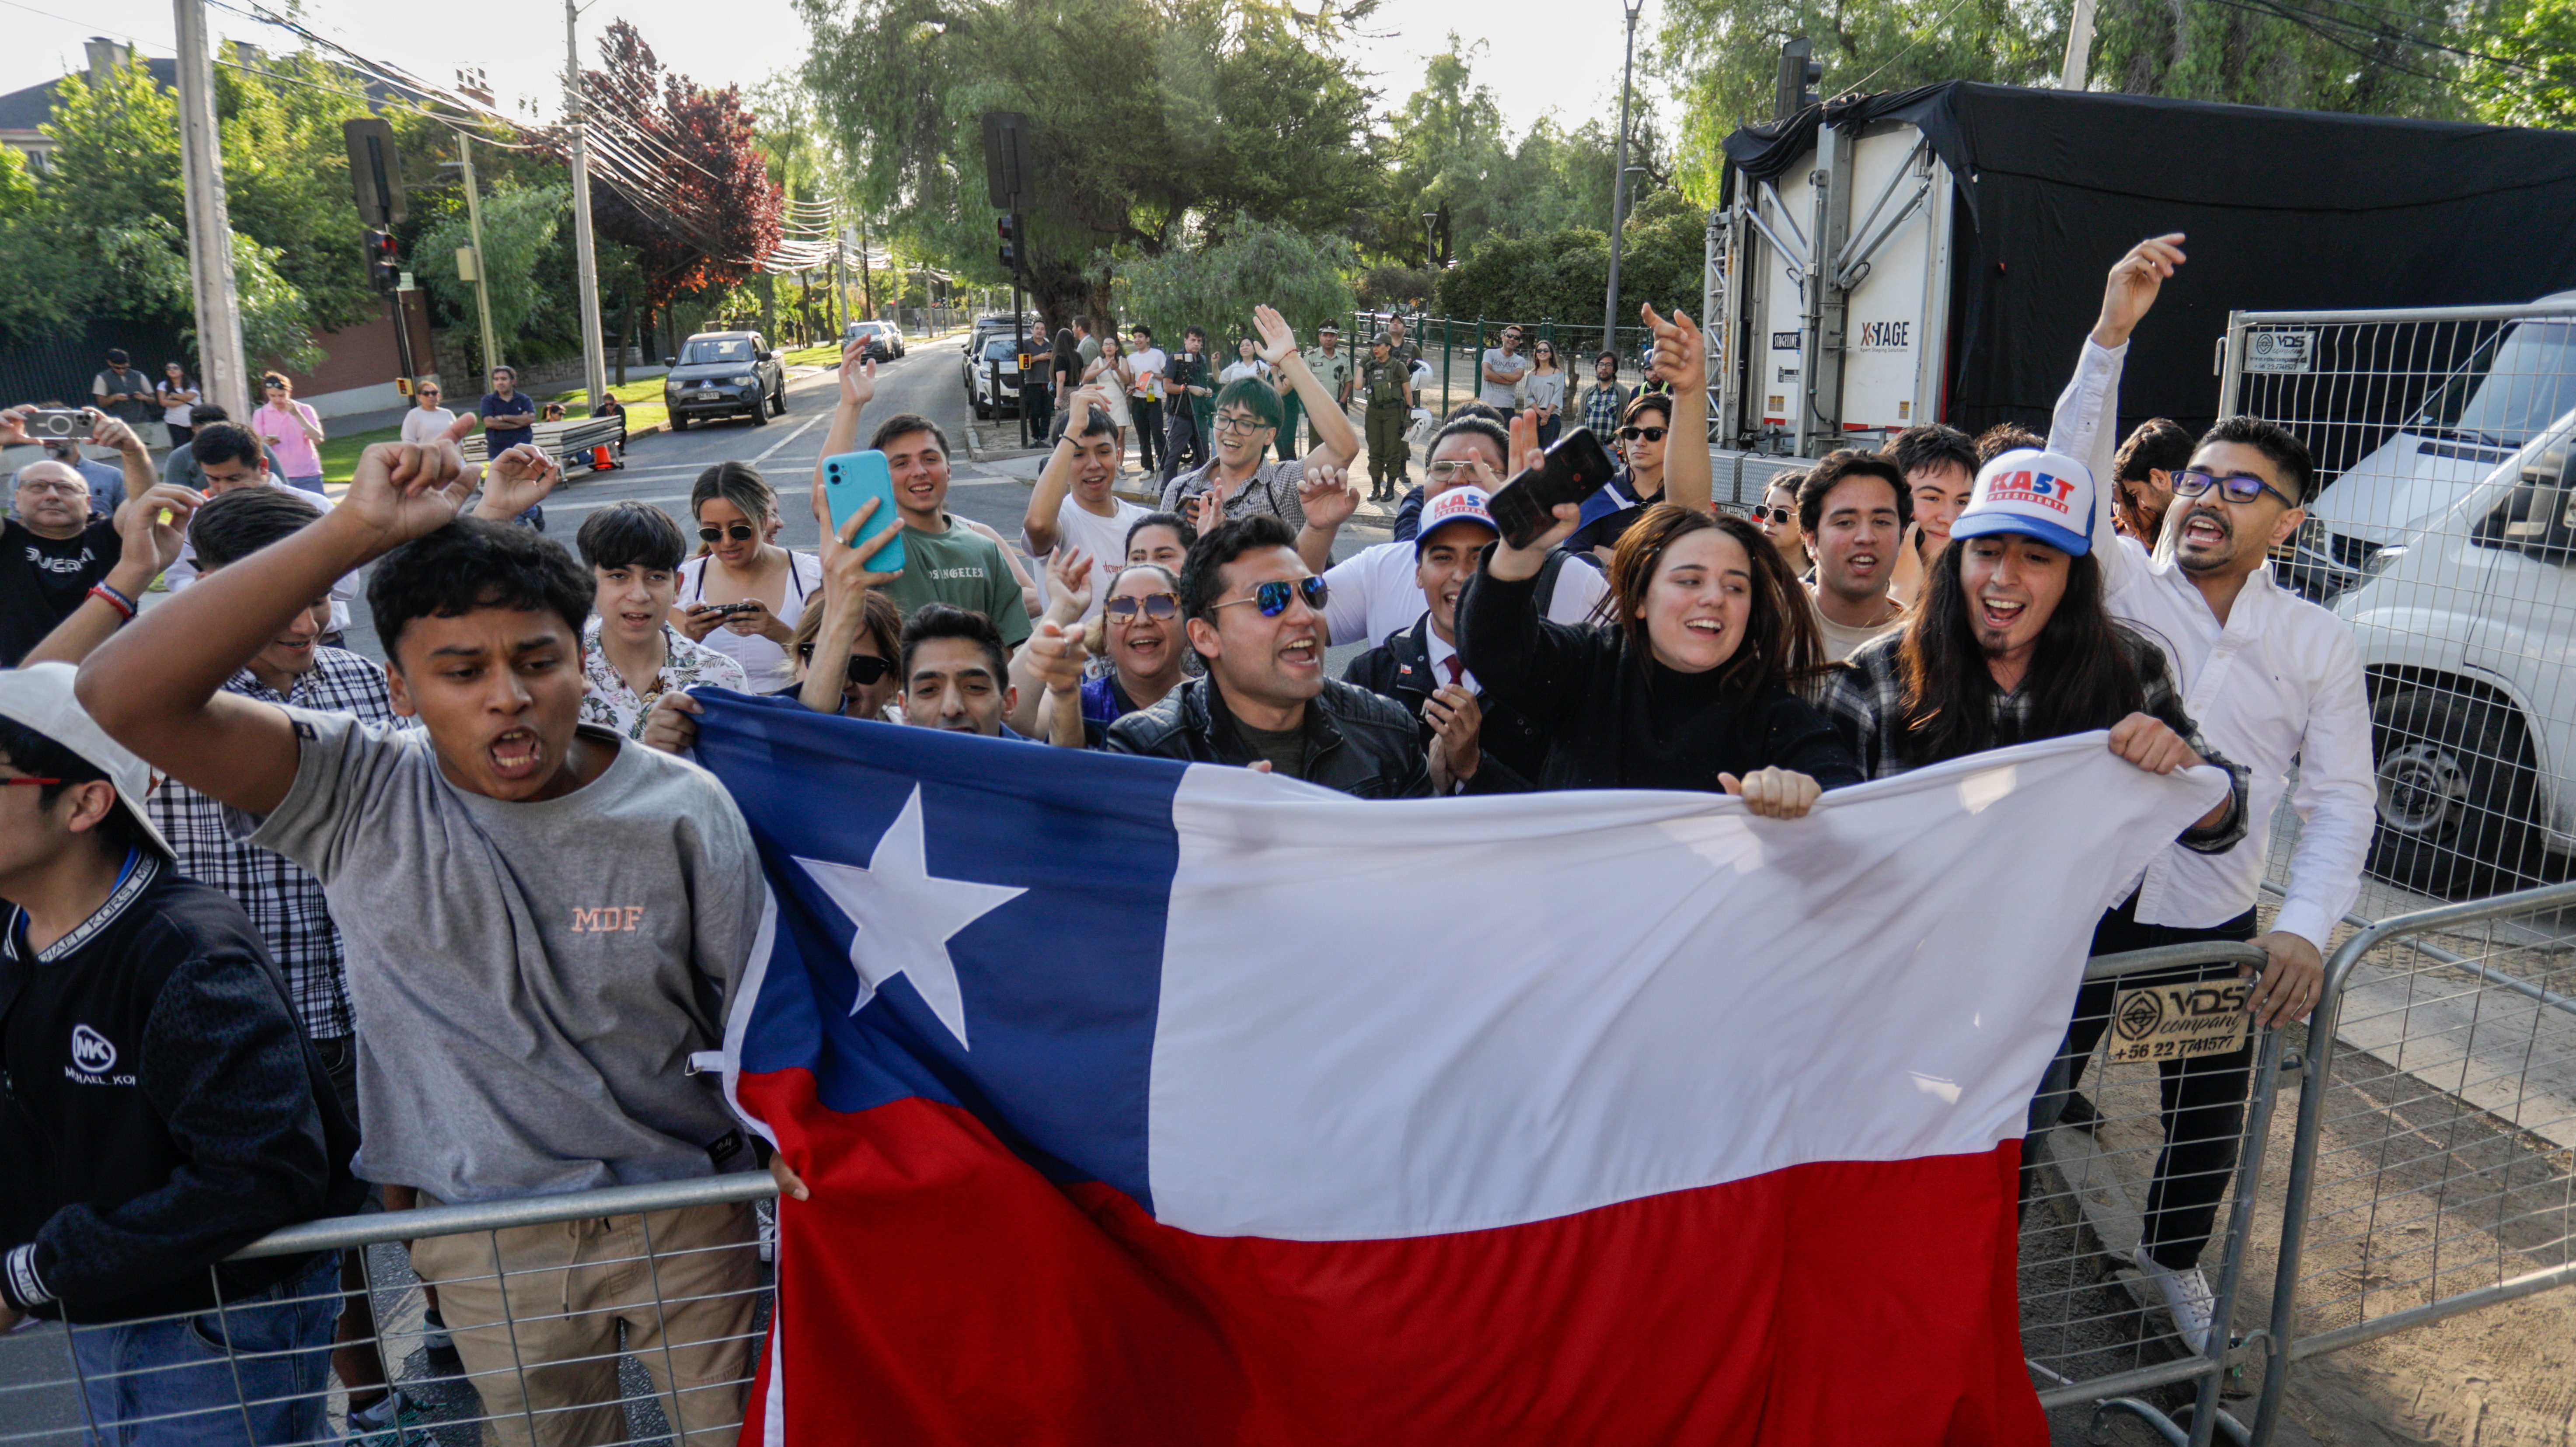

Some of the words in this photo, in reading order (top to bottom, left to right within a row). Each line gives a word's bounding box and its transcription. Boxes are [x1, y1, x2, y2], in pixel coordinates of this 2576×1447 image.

[1774, 335, 1799, 347] STAGELINE
[2277, 336, 2306, 347] VDS
[2272, 348, 2305, 357] company
[1492, 358, 1518, 368] LEONARDO
[1436, 507, 1488, 518] PRESIDENT
[1989, 493, 2066, 513] PRESIDENTE
[87, 887, 132, 929] KORS
[571, 906, 644, 932] MDF
[2169, 986, 2246, 1016] VDS
[2160, 1015, 2241, 1034] company
[76, 1035, 109, 1060] MK
[2116, 1044, 2150, 1060] +56
[2153, 1042, 2175, 1057] 22
[2178, 1035, 2235, 1058] 7741577
[65, 1064, 106, 1085] MHAEL
